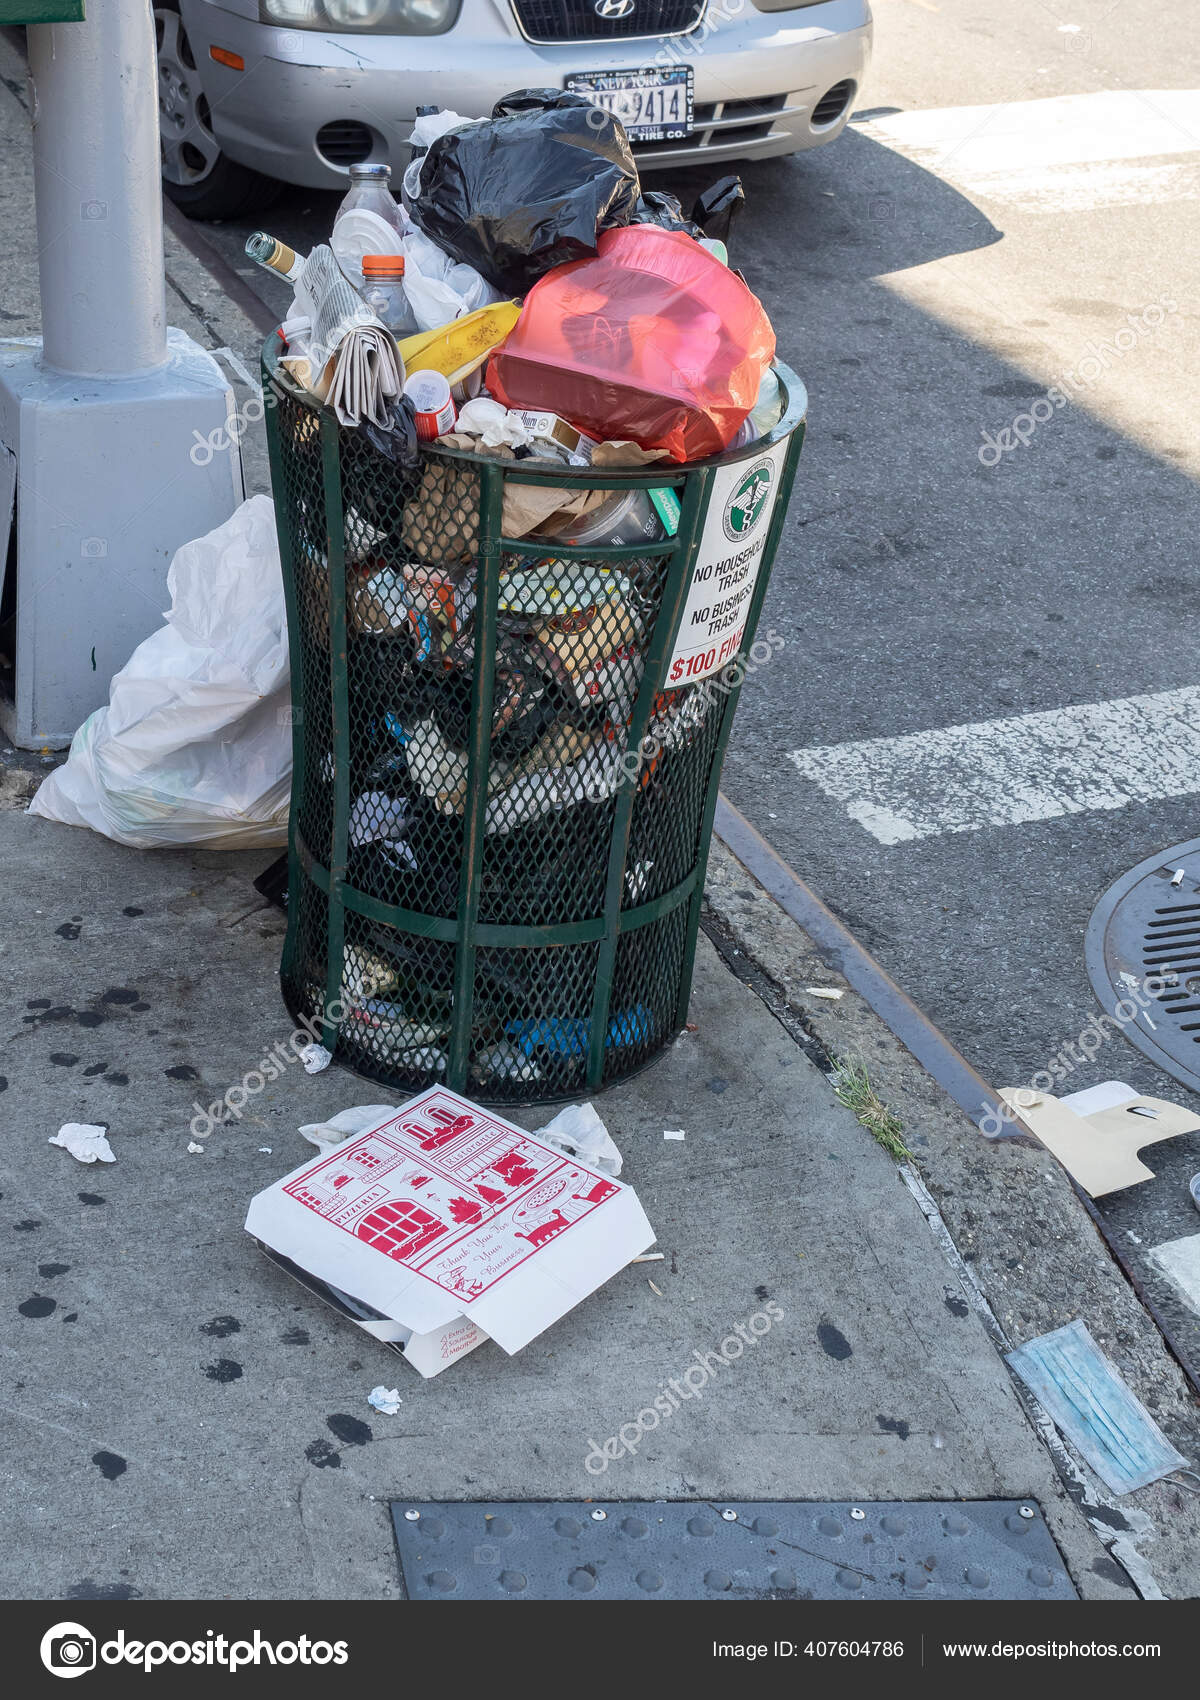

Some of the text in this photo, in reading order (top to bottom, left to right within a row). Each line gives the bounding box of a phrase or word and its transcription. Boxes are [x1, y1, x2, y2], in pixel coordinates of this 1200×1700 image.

[599, 75, 662, 91] NEW YORK
[686, 70, 694, 132] SERVICE
[638, 131, 665, 141] TIRE
[666, 129, 686, 139] CO.
[693, 564, 713, 584] NO
[718, 562, 751, 593] TRASH
[690, 606, 710, 626] NO
[707, 607, 740, 637] TRASH
[669, 623, 745, 683] $100 FINE
[445, 1130, 497, 1165] Ristorante
[335, 1191, 380, 1224] PIZZERIA
[436, 1222, 509, 1270] Thank You For
[472, 1244, 503, 1262] Your
[479, 1247, 525, 1276] Business
